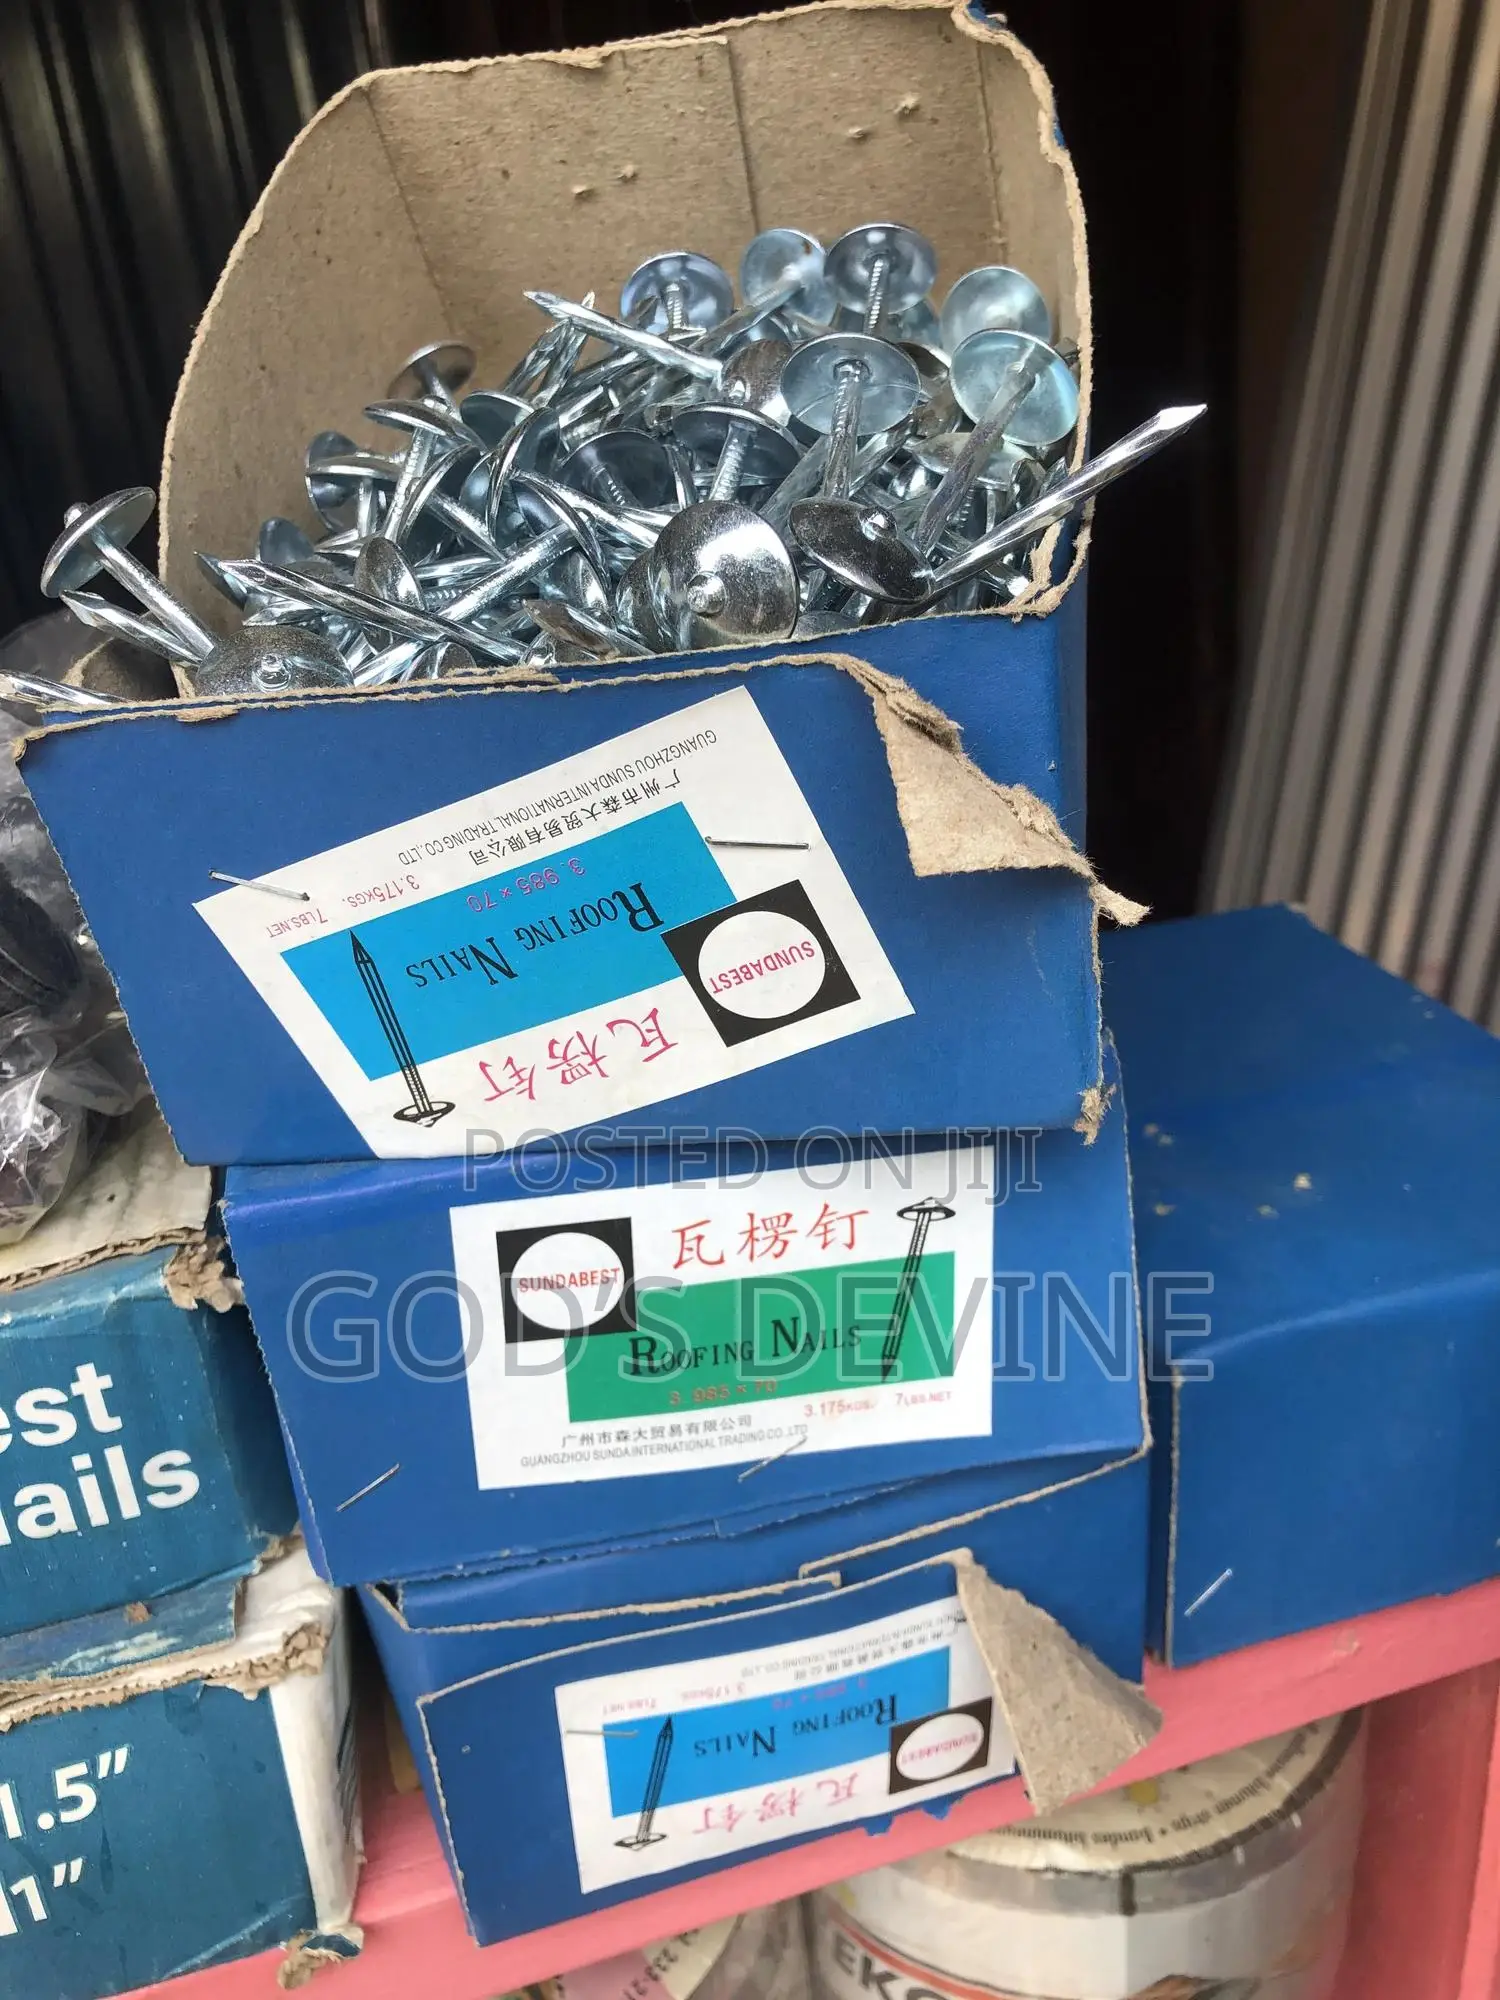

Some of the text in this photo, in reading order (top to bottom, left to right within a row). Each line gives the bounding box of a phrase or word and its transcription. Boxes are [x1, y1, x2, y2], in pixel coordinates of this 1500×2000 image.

[635, 729, 717, 767] GUANGZHOU
[591, 763, 636, 791] SUNDA
[468, 768, 681, 866] 广州市森大贸易有限公司
[495, 781, 593, 831] INTERNATIONAL
[442, 819, 497, 849] TRADING
[405, 882, 665, 987] ROOFING NAILS
[711, 938, 815, 998] SUNDABEST
[517, 1266, 621, 1293] SUNDABEST
[0, 1362, 123, 1454] est
[520, 1450, 591, 1468] GUANGZHOU
[0, 1444, 200, 1546] ails
